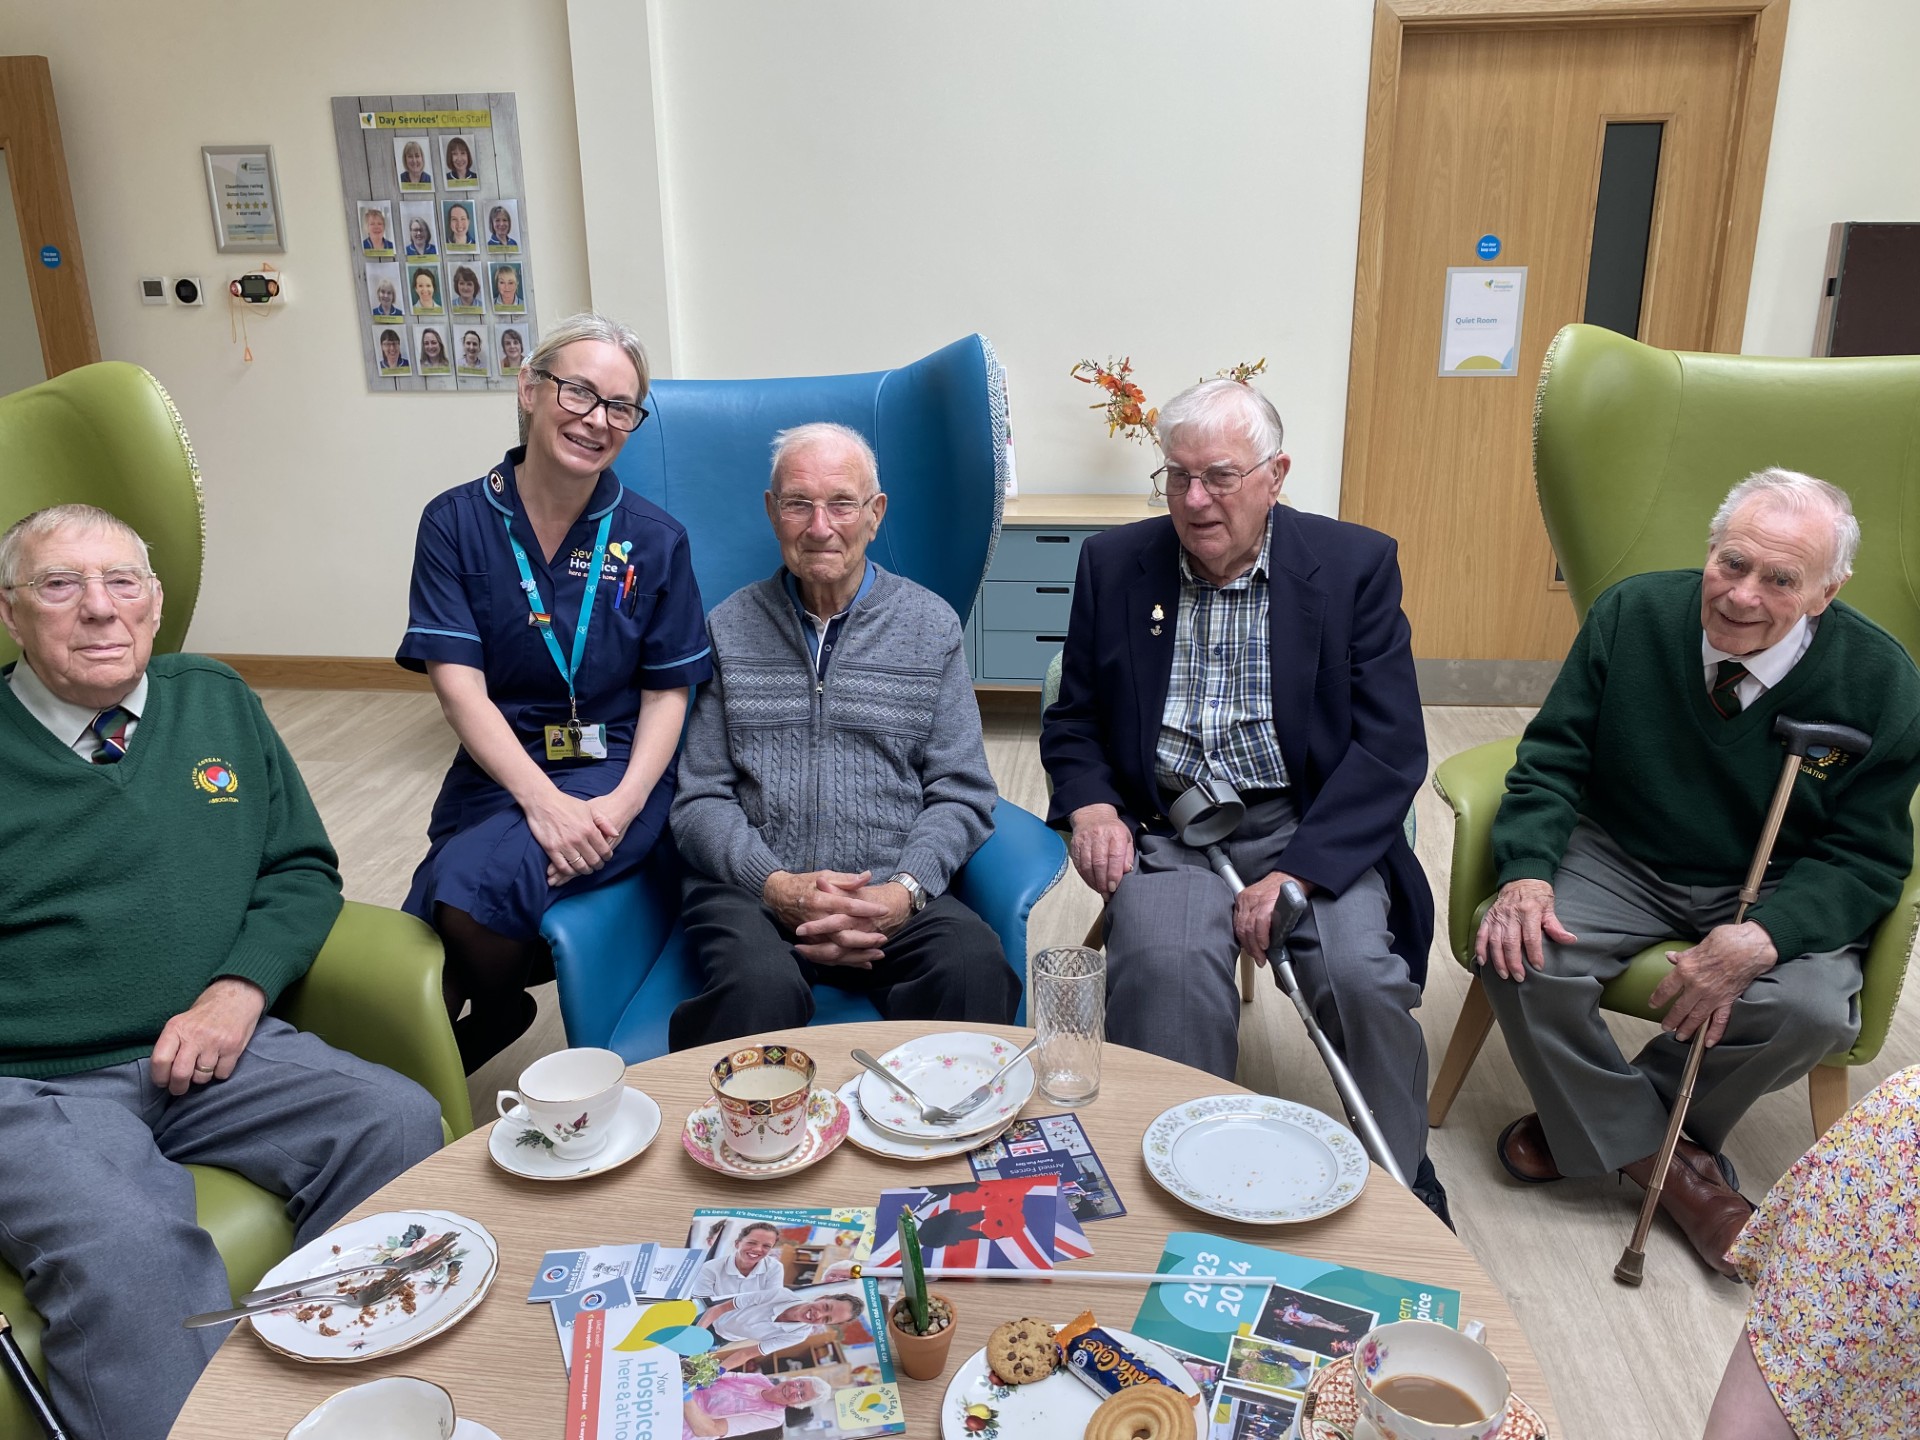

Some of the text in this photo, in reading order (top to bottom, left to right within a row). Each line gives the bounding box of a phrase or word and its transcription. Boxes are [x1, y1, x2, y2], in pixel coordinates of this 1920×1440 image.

[378, 113, 488, 126] Day Services' Clinic Staff
[1455, 317, 1475, 325] Quiet
[570, 548, 611, 562] Sevn
[570, 557, 618, 573] Hosice
[1038, 1163, 1065, 1172] Armed
[746, 1211, 773, 1220] because
[565, 1251, 586, 1292] Armed Forces
[869, 1288, 878, 1307] because
[872, 1308, 880, 1319] you
[1398, 1297, 1413, 1320] ern
[877, 1330, 885, 1343] that
[880, 1343, 886, 1352] we
[1078, 1338, 1120, 1372] Cakes
[617, 1359, 634, 1389] here
[656, 1372, 669, 1395] Your
[615, 1392, 632, 1401] &
[632, 1361, 660, 1440] Hospice
[879, 1386, 898, 1421] 35 YEARS
[616, 1402, 631, 1420] at
[848, 1389, 870, 1423] SPECIAL UPDATE
